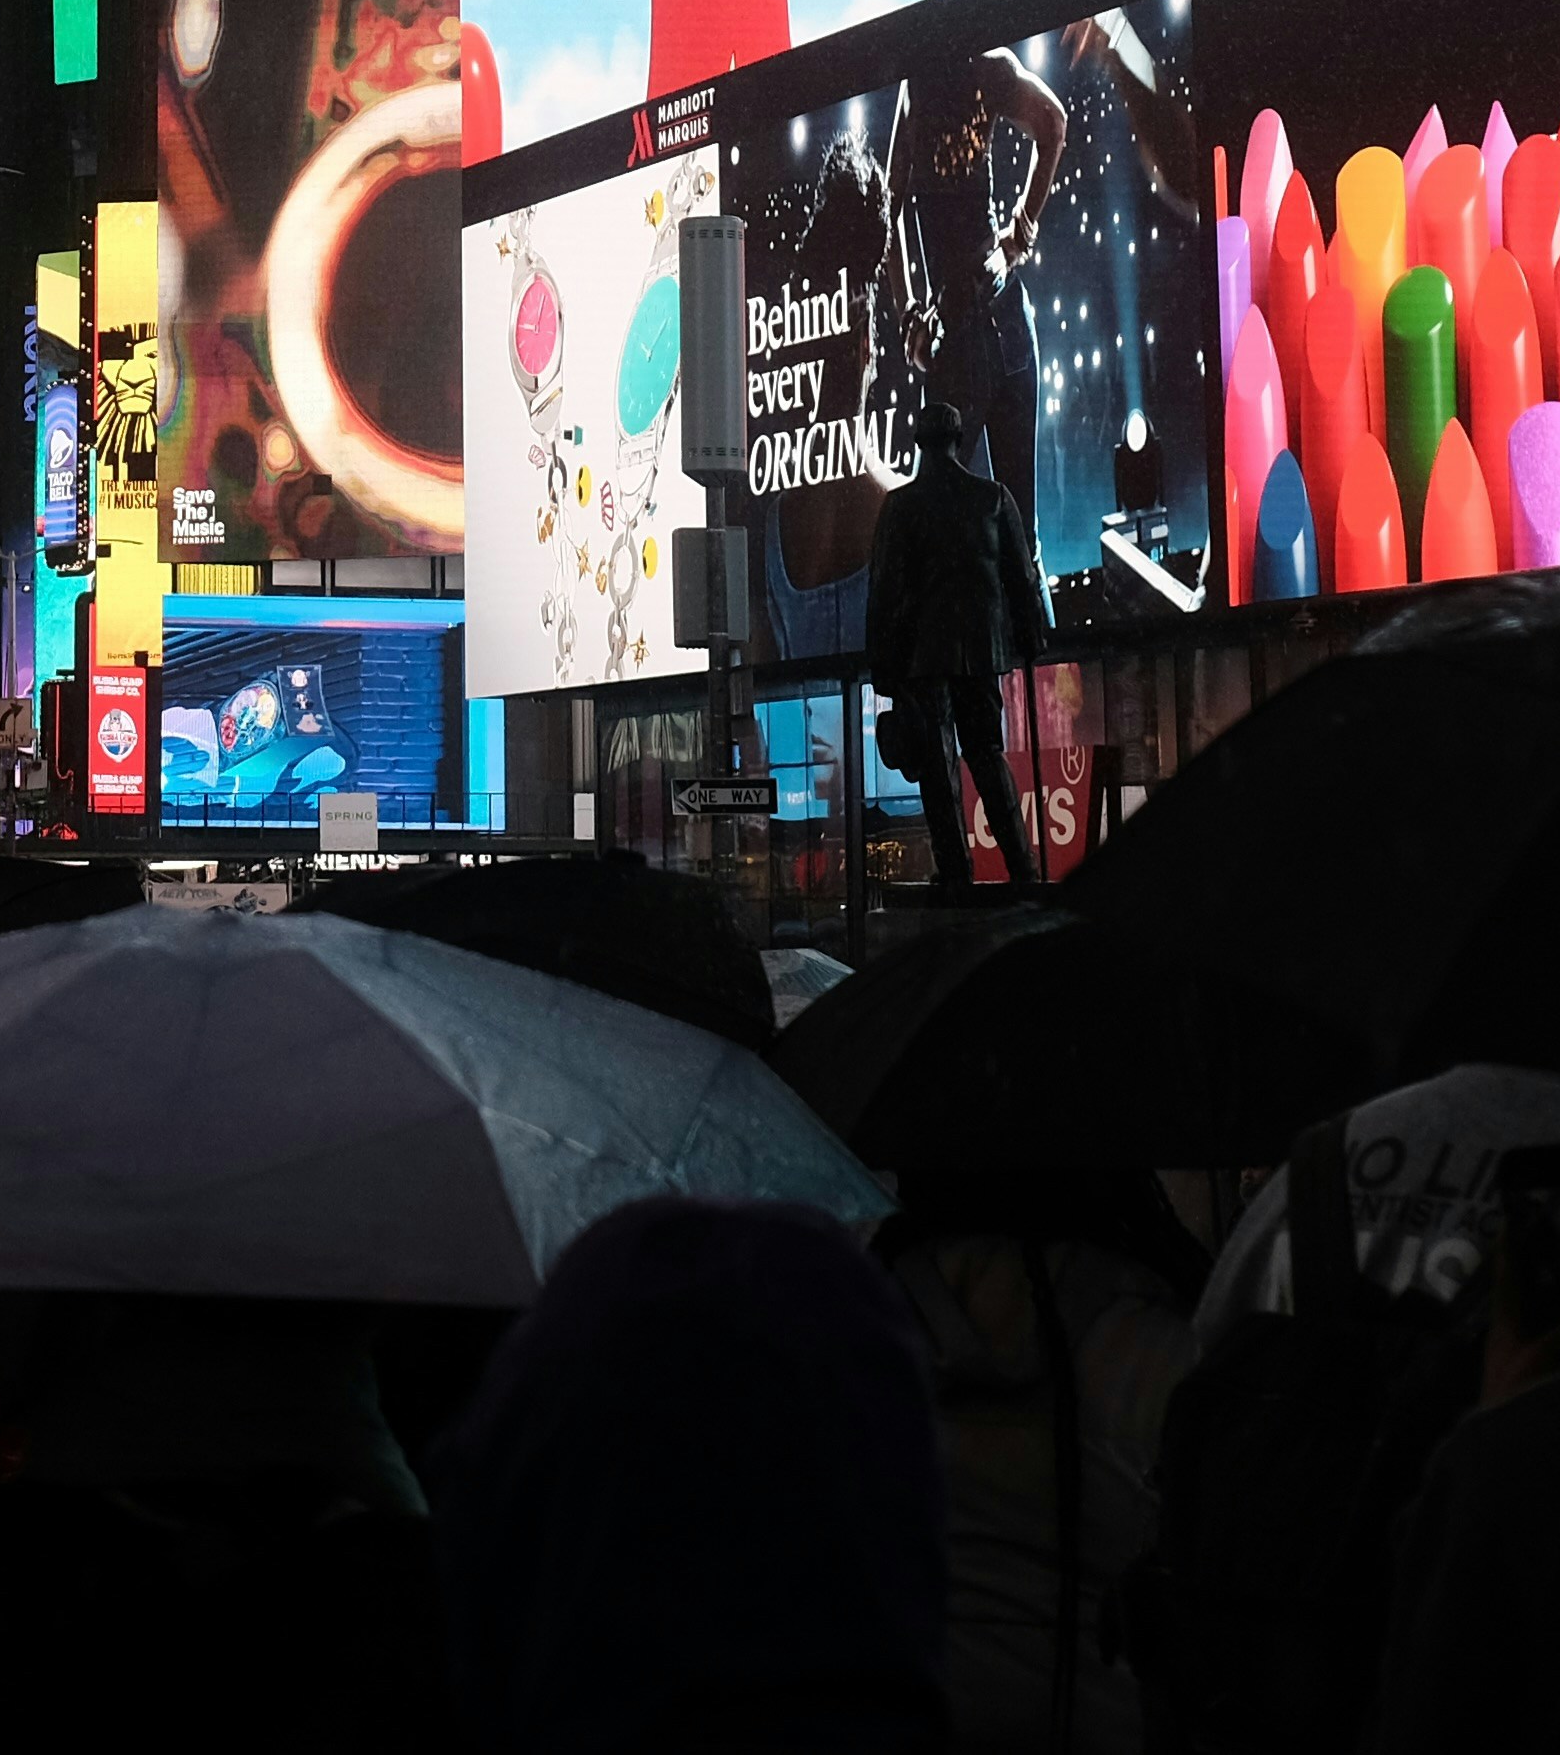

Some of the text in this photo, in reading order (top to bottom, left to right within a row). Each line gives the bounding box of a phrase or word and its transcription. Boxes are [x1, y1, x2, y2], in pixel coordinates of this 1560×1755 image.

[658, 87, 715, 124] MARRIOTT
[658, 116, 709, 150] MARQUIS
[747, 267, 851, 356] Behind
[748, 359, 825, 424] every
[47, 470, 74, 486] TACO
[101, 479, 120, 491] THE
[49, 485, 74, 502] BELL
[172, 487, 216, 504] Save
[173, 503, 208, 521] The
[172, 519, 225, 537] Music
[172, 536, 225, 545] FOUNDATION
[688, 789, 764, 804] ONE WAY
[325, 810, 373, 822] SPRING
